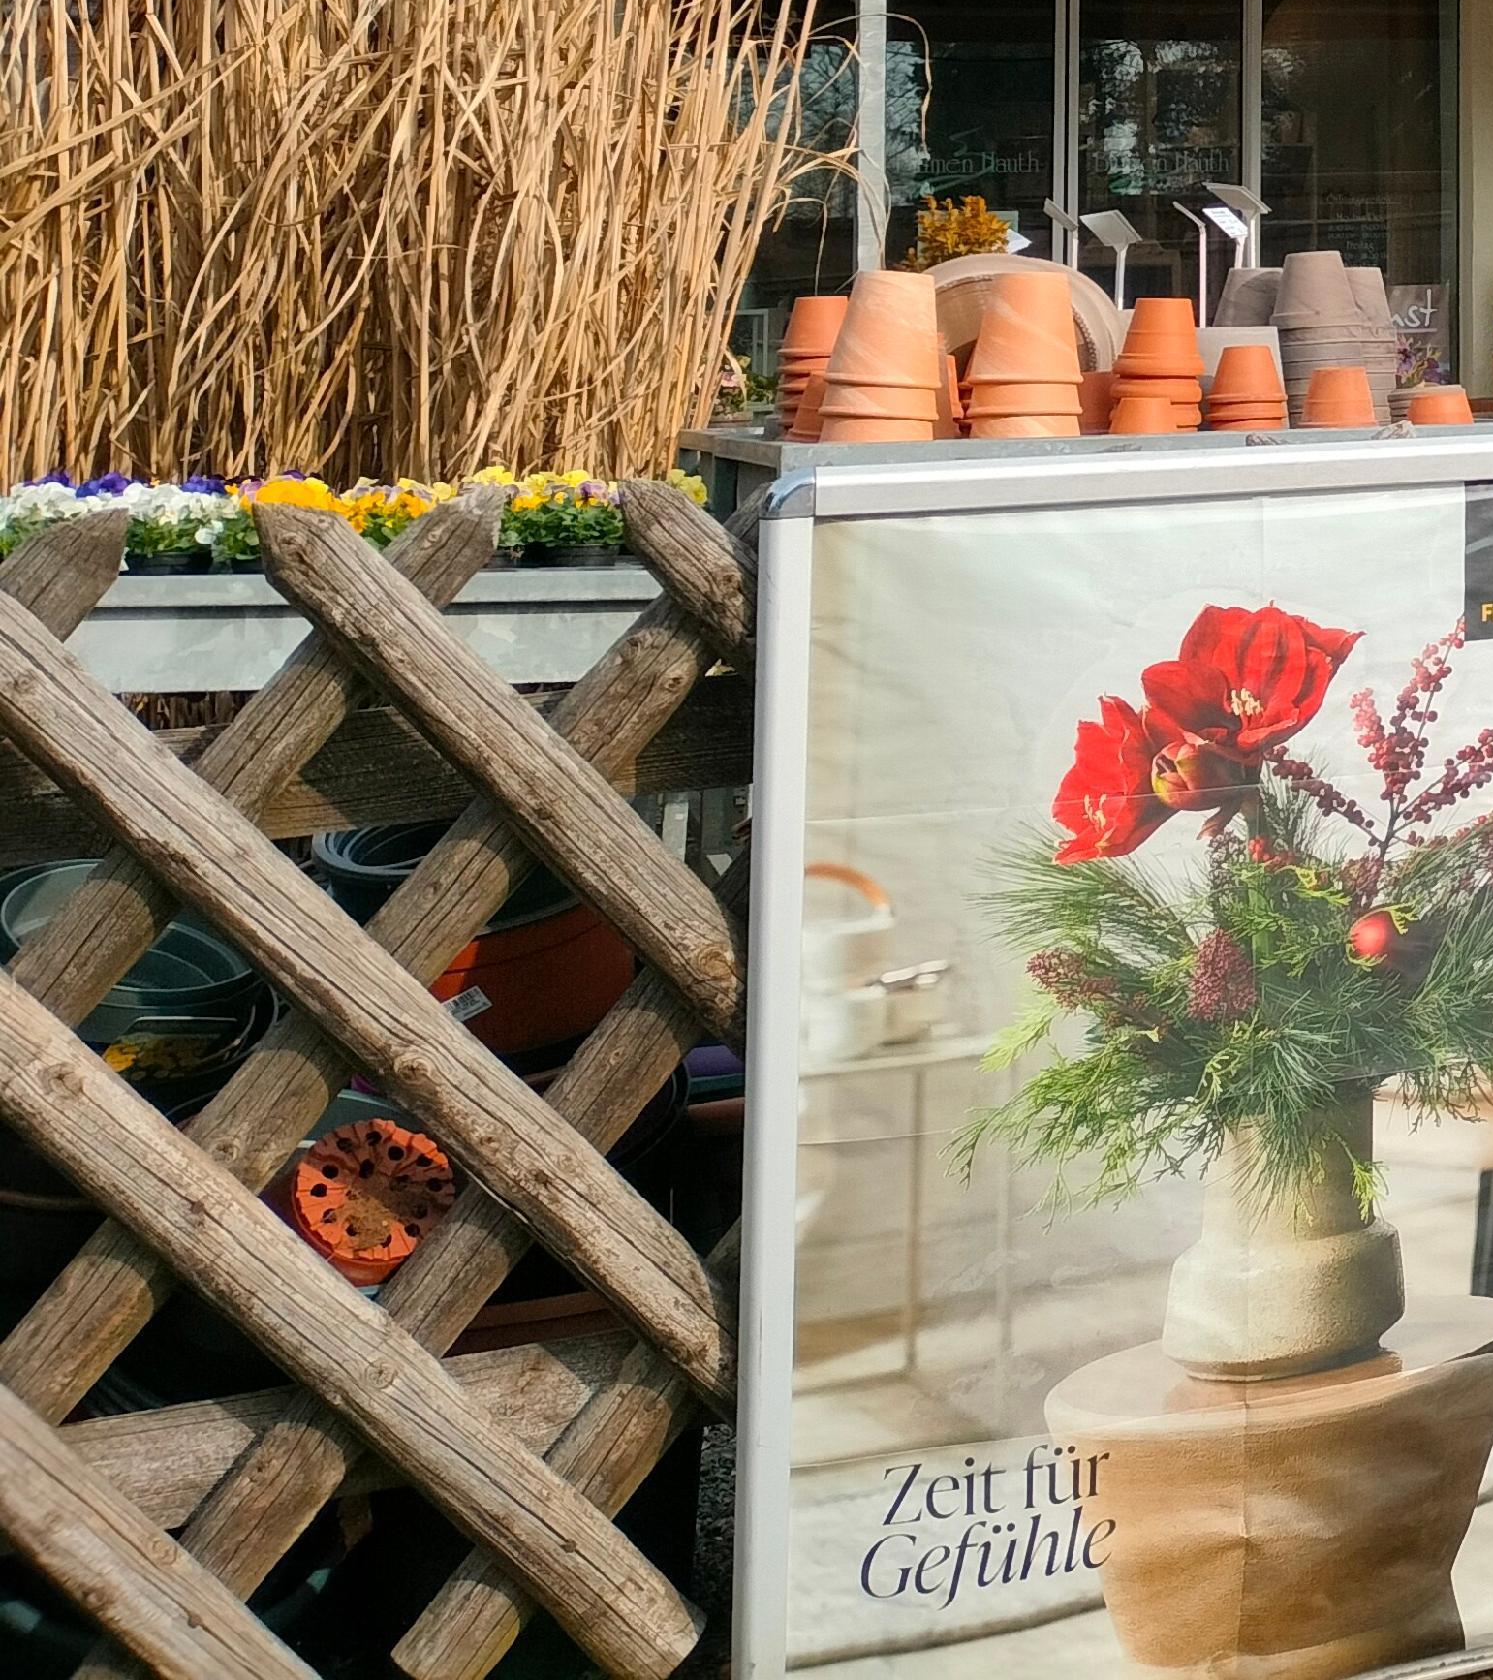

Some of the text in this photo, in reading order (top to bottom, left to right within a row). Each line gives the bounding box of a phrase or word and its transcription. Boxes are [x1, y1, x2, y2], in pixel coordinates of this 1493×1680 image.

[882, 1444, 1110, 1526] Zeit für
[859, 1507, 1117, 1610] Gefühle
